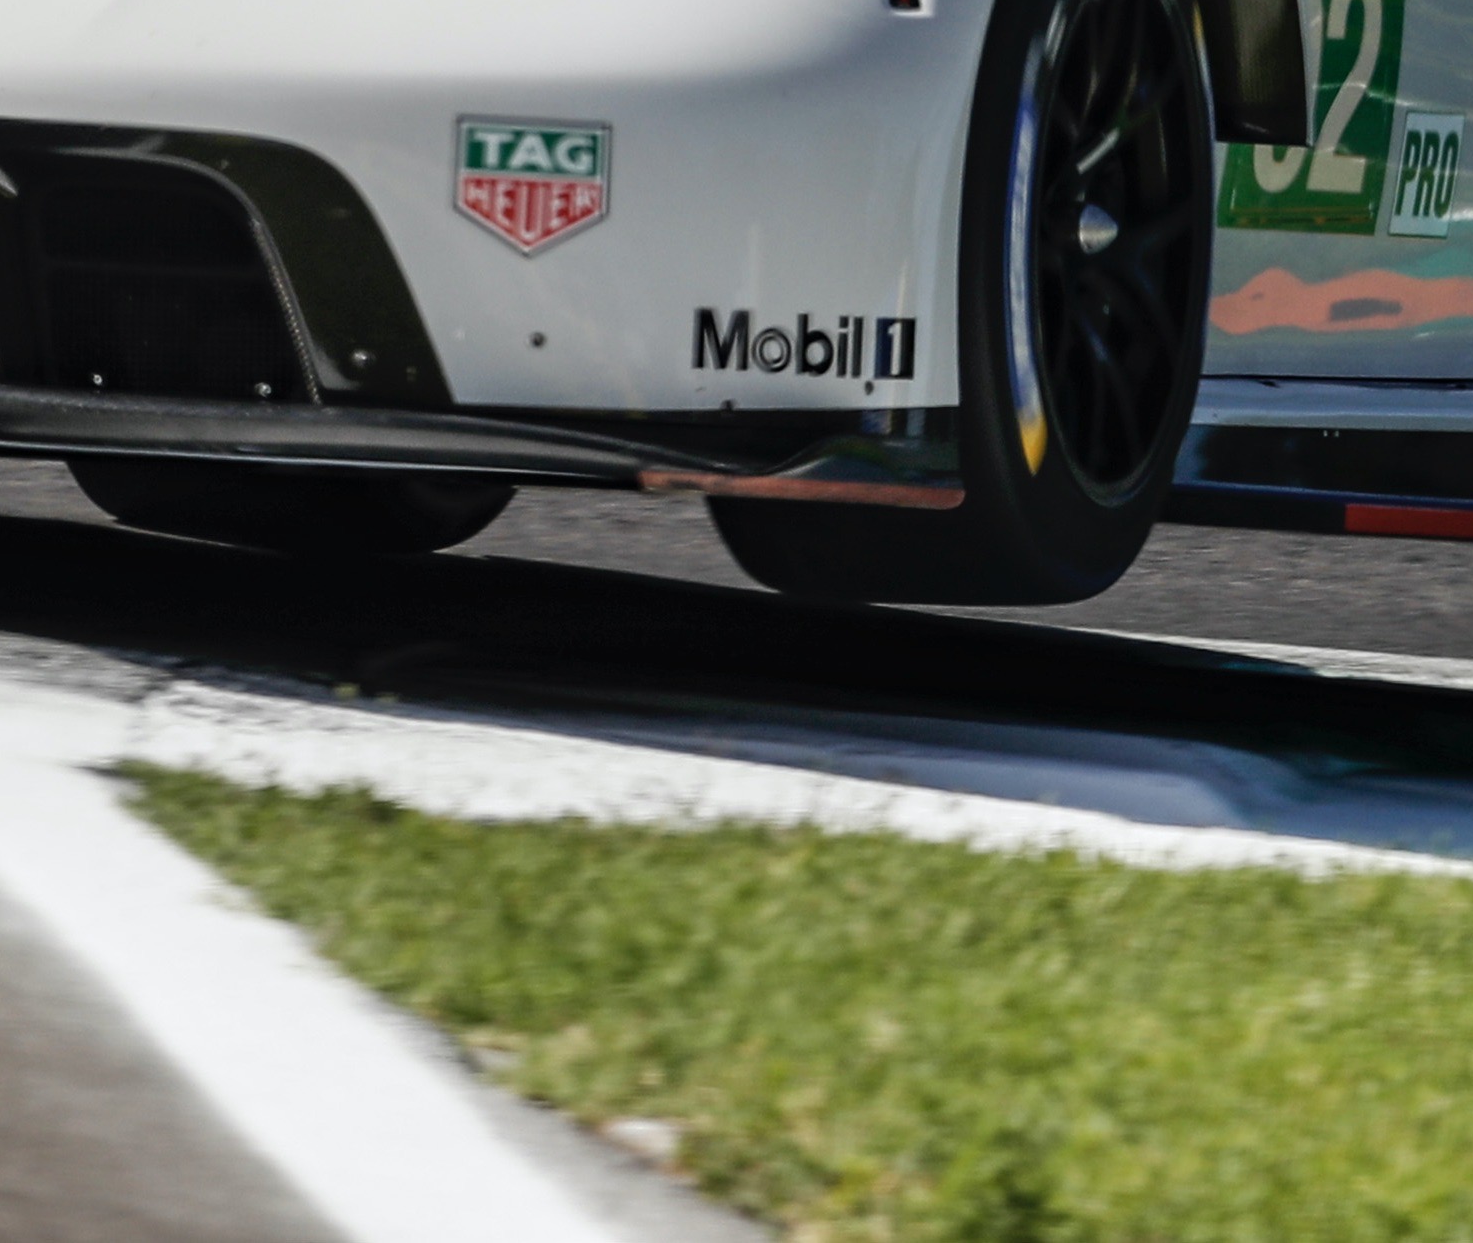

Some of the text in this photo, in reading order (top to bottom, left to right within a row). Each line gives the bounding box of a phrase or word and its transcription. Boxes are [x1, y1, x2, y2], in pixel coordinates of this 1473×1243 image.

[474, 131, 594, 175] TAG
[1395, 129, 1459, 219] PRO
[464, 181, 601, 241] HEUER
[691, 307, 864, 379] Mobil
